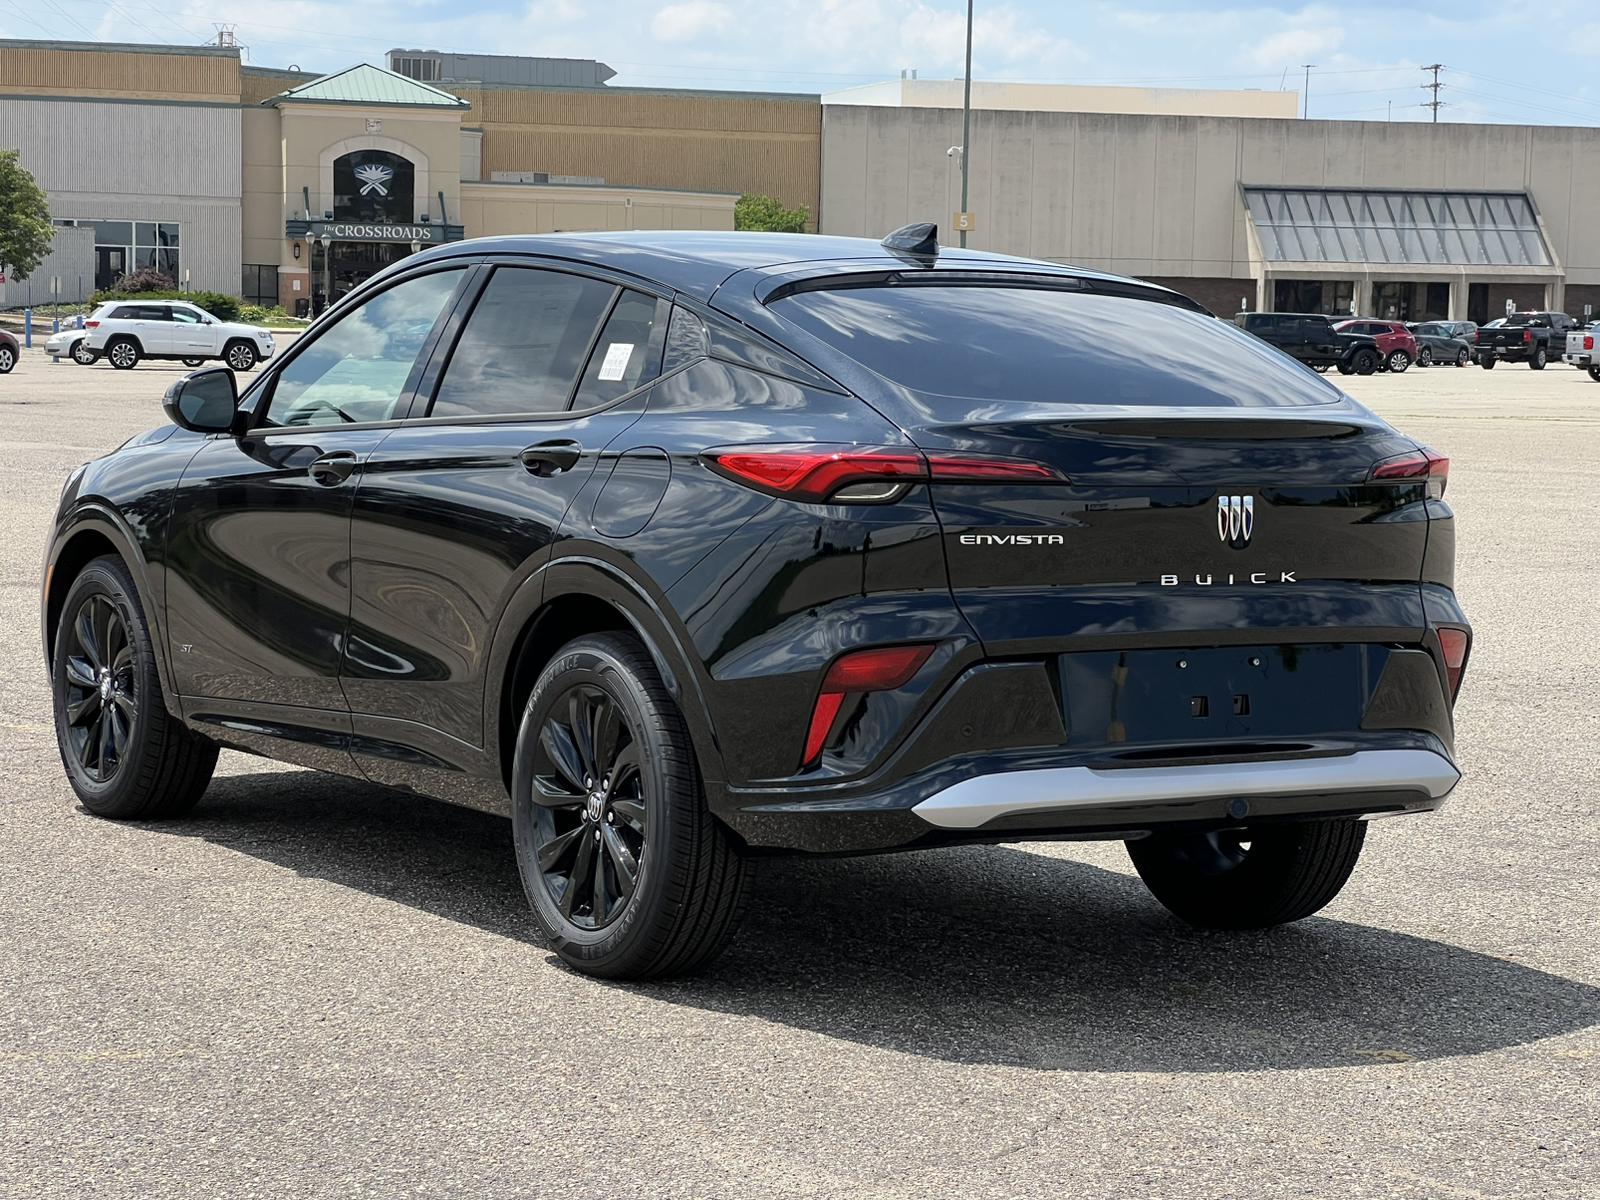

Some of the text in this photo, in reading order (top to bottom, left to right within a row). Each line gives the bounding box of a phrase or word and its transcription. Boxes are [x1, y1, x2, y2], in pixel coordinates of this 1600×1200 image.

[960, 215, 968, 228] 5
[324, 224, 431, 239] The CROSSROADS
[959, 534, 1064, 545] ENVISTA
[1160, 571, 1297, 586] BUICK
[181, 644, 193, 653] ST
